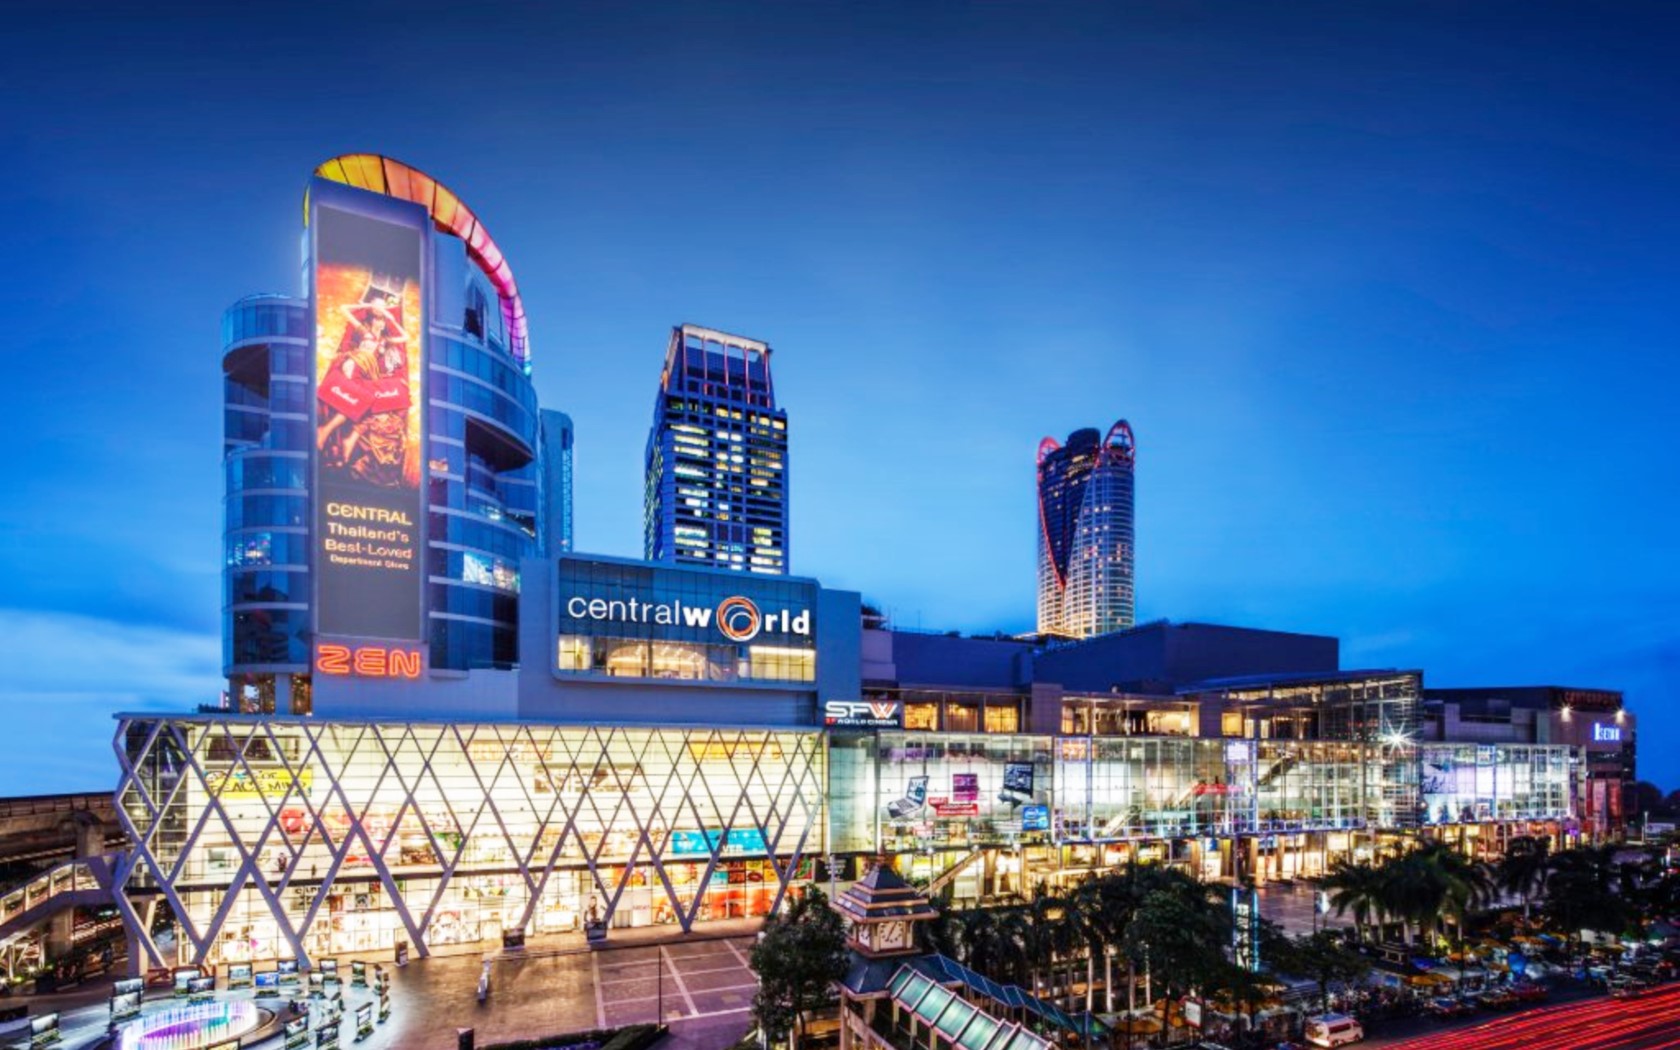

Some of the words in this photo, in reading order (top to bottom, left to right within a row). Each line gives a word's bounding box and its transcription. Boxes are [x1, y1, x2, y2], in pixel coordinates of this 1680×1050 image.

[327, 502, 413, 526] CENTRAL
[327, 522, 409, 543] Thailand's
[325, 538, 412, 559] Best-Loved
[317, 645, 420, 678] ZEN
[825, 701, 898, 719] SFW
